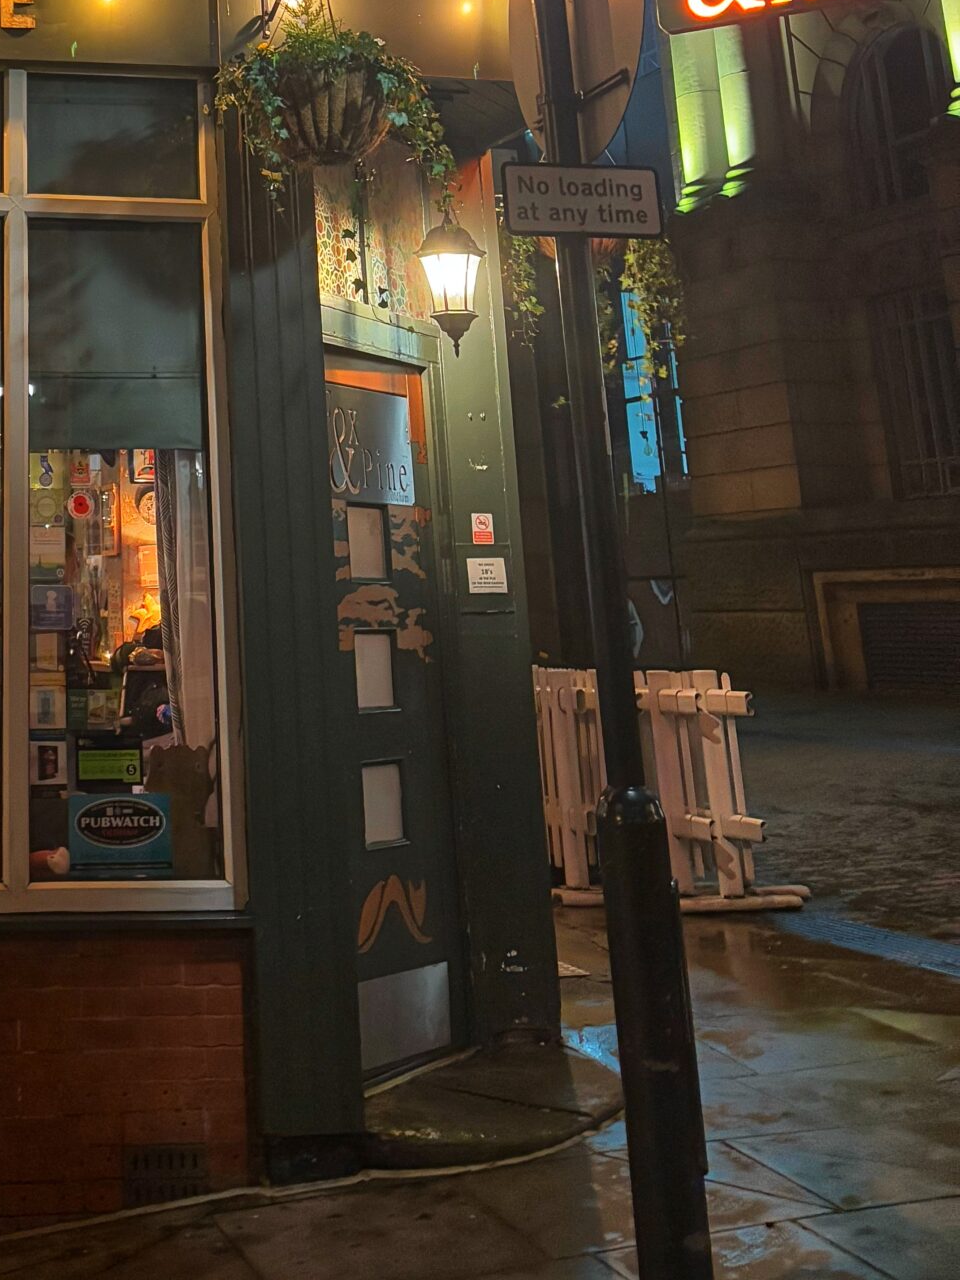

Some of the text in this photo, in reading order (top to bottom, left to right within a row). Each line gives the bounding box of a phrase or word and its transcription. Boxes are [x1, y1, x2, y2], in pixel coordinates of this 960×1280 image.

[517, 175, 643, 202] No loading
[517, 202, 649, 226] at any time
[362, 448, 410, 494] Pine
[80, 815, 160, 828] PUBWATCH
